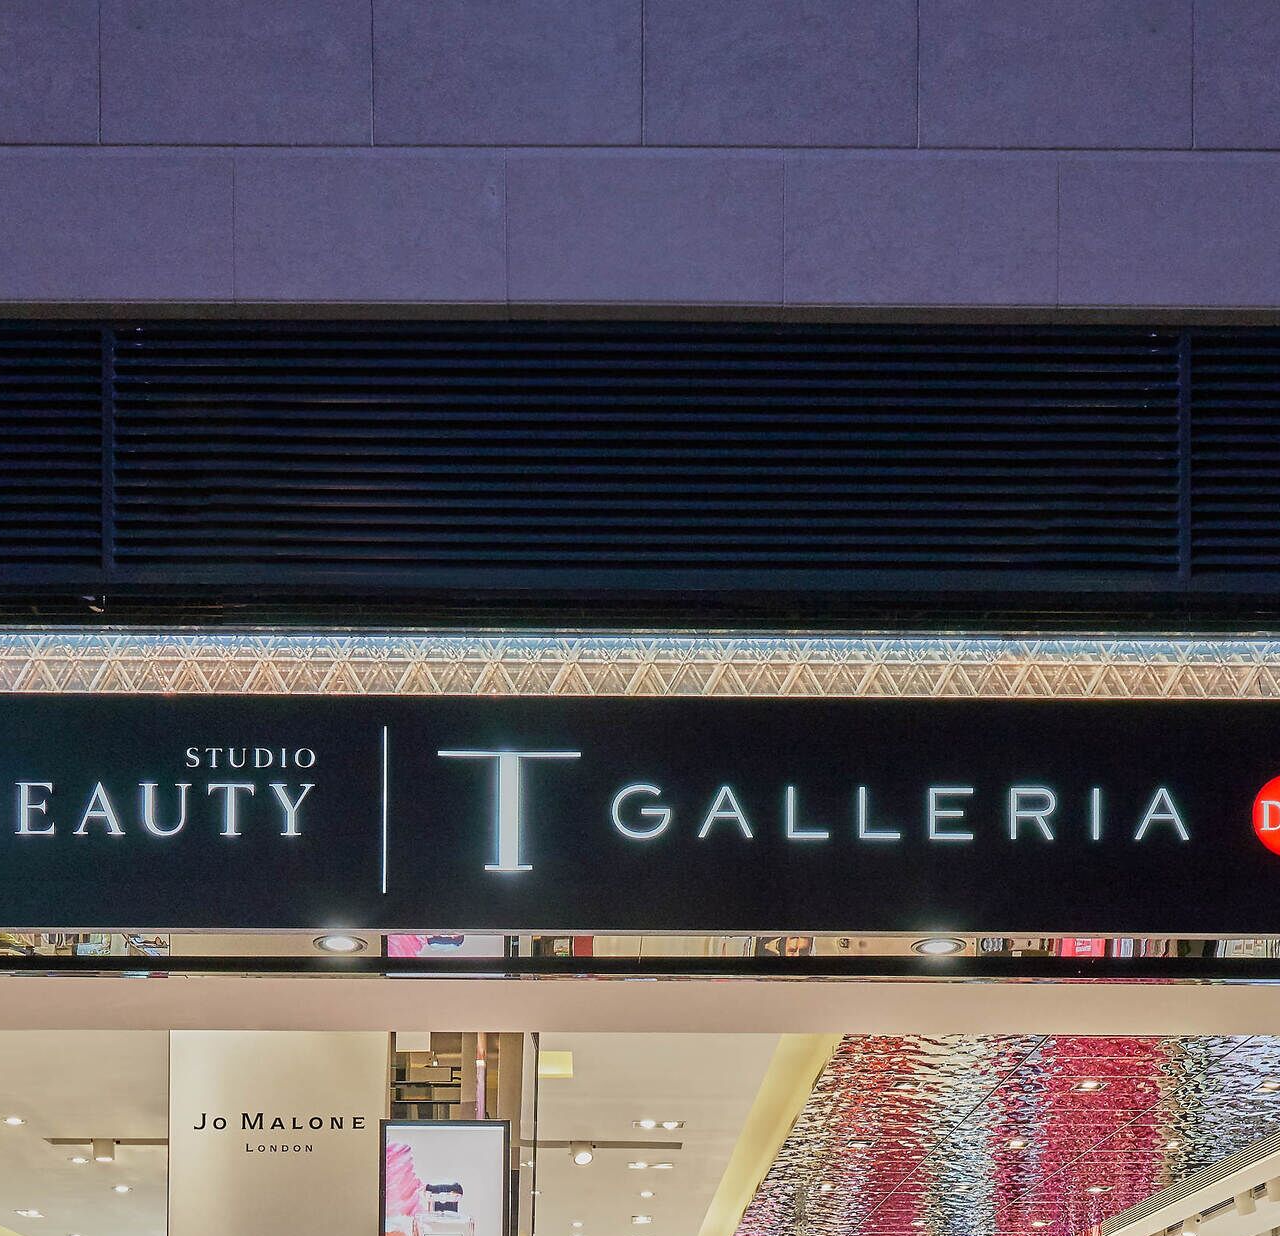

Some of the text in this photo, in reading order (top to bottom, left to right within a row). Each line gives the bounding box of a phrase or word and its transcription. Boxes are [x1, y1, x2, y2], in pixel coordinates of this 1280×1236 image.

[185, 746, 317, 769] STUDIO
[436, 749, 1191, 872] T GALLERIA
[194, 1112, 366, 1130] JO MALONE
[245, 1143, 313, 1153] LONDON
